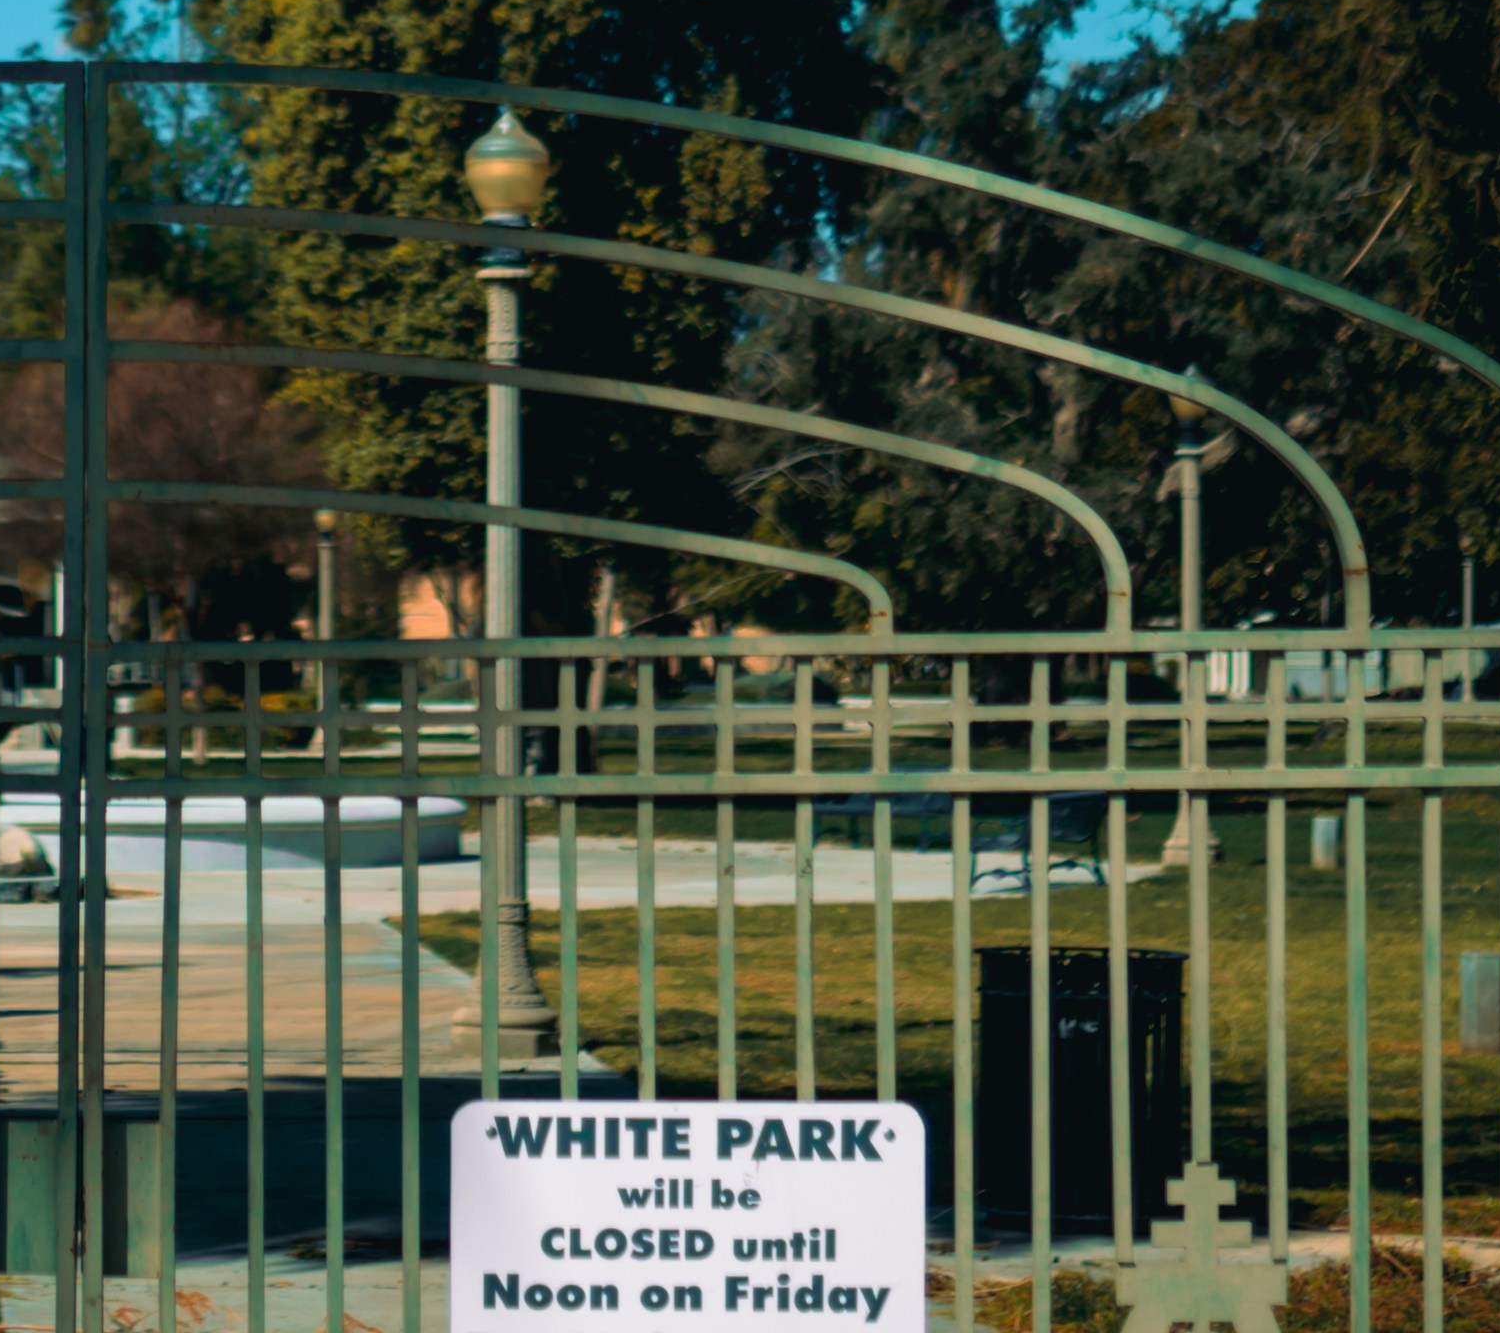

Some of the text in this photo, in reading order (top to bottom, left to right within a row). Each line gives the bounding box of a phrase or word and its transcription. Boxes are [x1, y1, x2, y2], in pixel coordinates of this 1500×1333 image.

[495, 1116, 883, 1162] WHITE PARK
[618, 1178, 761, 1210] will be
[540, 1227, 836, 1261] CLOSED until
[483, 1273, 890, 1323] Noon on Friday
